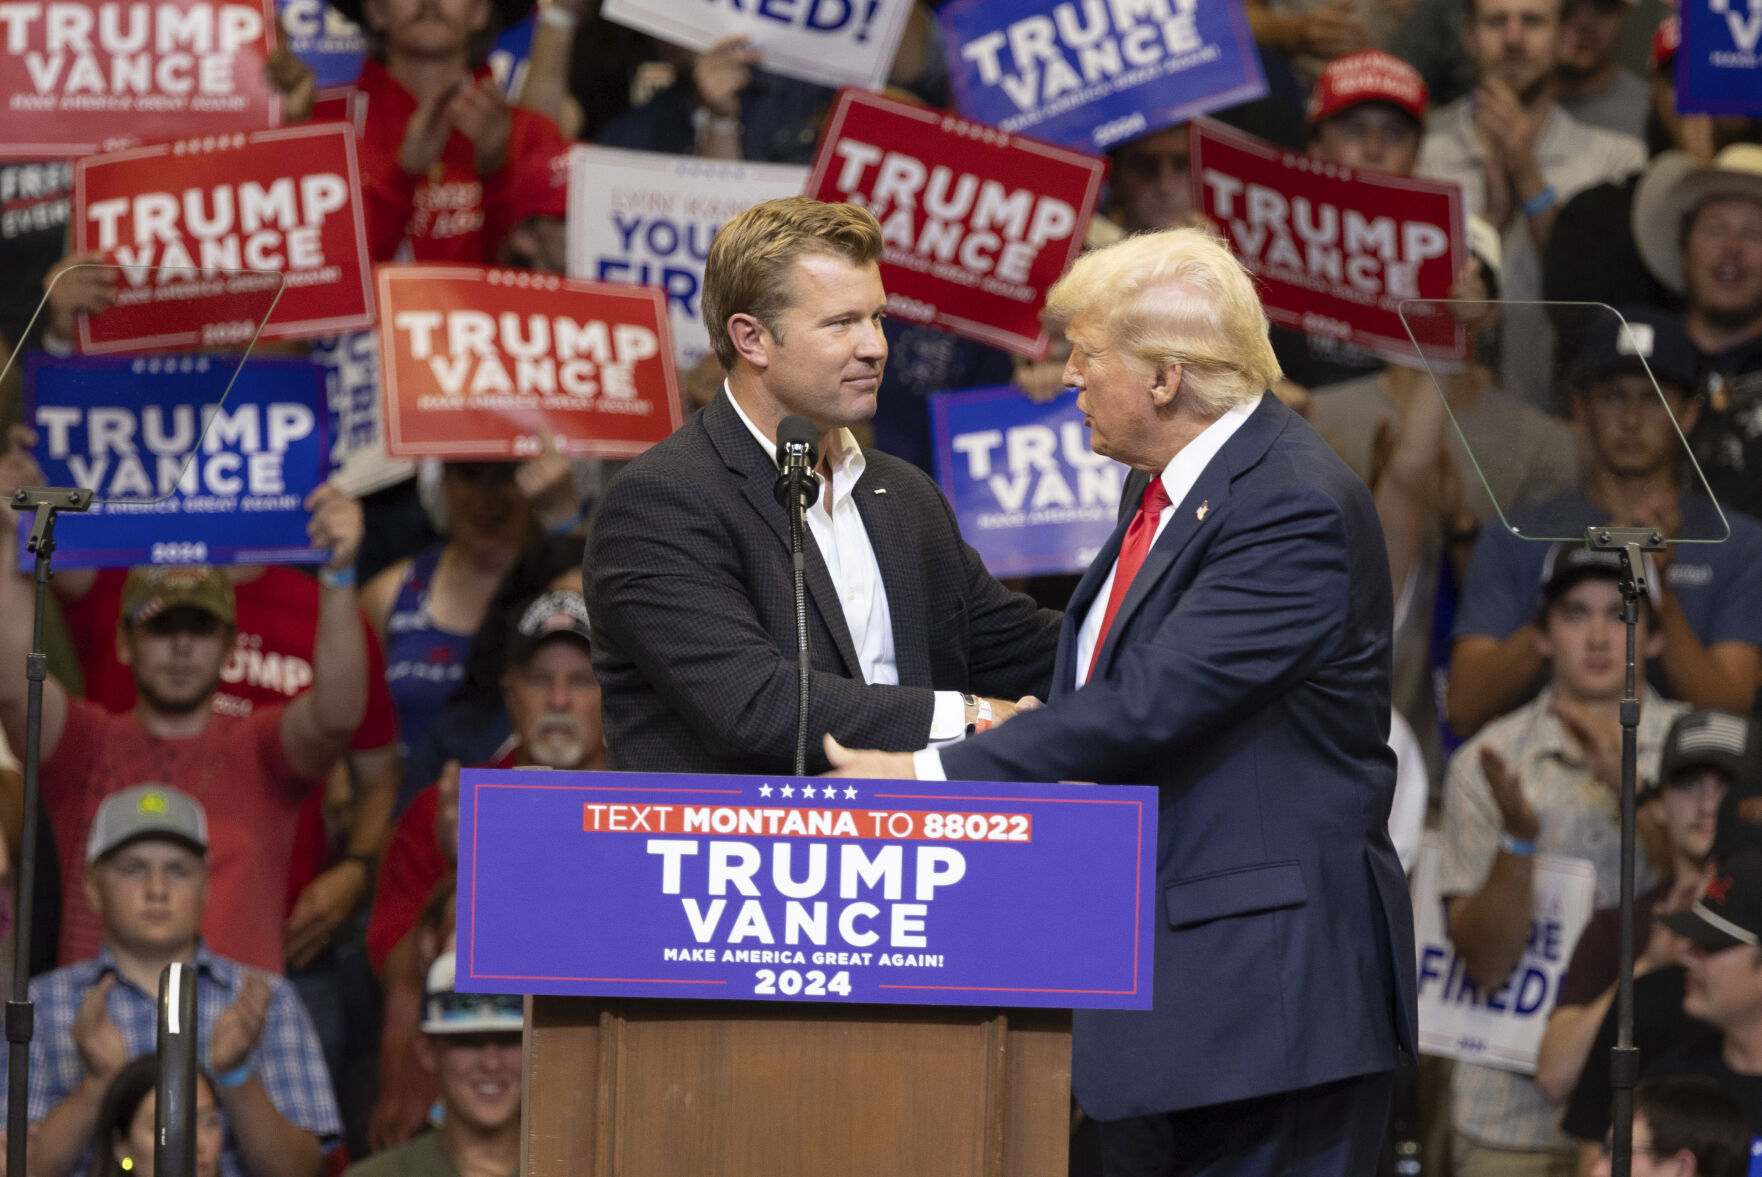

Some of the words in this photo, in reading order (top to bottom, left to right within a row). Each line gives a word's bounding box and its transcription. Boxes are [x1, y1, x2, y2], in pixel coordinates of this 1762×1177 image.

[0, 2, 264, 56] TRUMP
[24, 52, 236, 95] VANCE
[1001, 13, 1205, 113] VANCE
[88, 172, 350, 250] TRUMP
[835, 137, 1077, 252] TRUMP
[1203, 167, 1450, 263] TRUMP
[115, 226, 327, 288] VANCE
[1229, 216, 1421, 299] VANCE
[395, 310, 659, 363] TRUMP
[428, 353, 638, 399] VANCE
[35, 402, 316, 459] TRUMP
[66, 451, 286, 500] VANCE
[587, 804, 673, 832] TEXT
[683, 807, 859, 837] MONTANA
[868, 812, 914, 838] TO
[923, 813, 1029, 841] 88022
[647, 839, 967, 901] TRUMP
[681, 898, 928, 948] VANCE
[664, 948, 716, 963] MAKE
[722, 949, 806, 965] AMERICA
[812, 951, 873, 966] GREAT
[879, 953, 945, 968] AGAIN!
[754, 969, 852, 997] 2024
